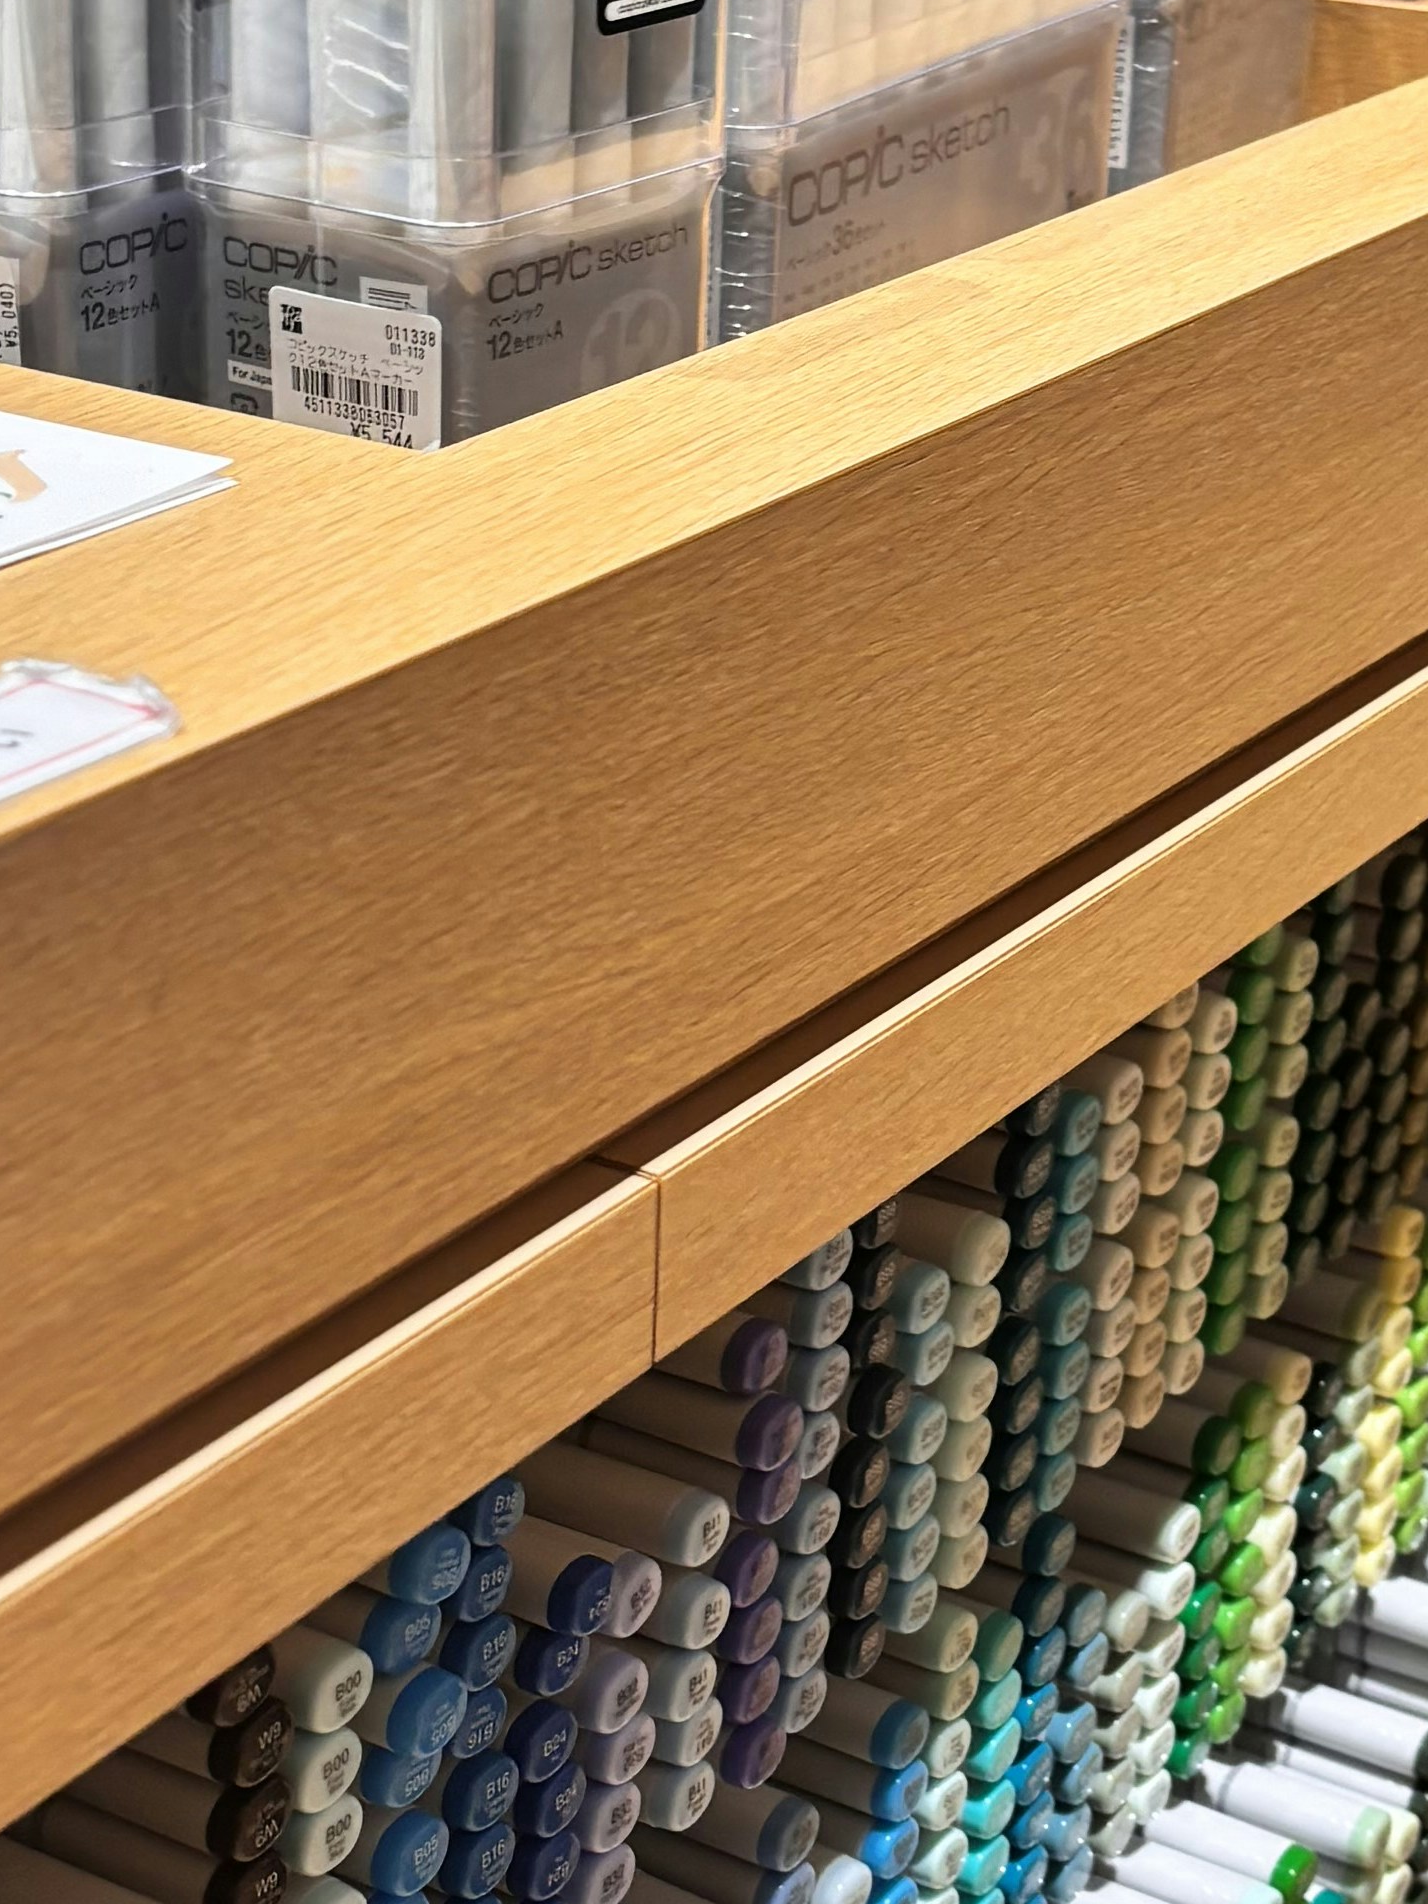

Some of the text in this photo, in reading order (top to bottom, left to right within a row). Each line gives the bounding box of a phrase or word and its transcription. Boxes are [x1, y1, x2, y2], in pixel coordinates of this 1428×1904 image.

[910, 101, 1010, 174] sketch
[597, 223, 688, 271] sketch
[79, 275, 138, 300] ベーシック
[80, 293, 161, 332] 12色セットA
[489, 303, 544, 328] ベーシック
[385, 324, 436, 347] 011338
[487, 320, 563, 361] 12色セットA
[287, 338, 369, 363] コピックスケッチ
[232, 366, 247, 380] For
[336, 1670, 362, 1699] B00
[324, 1747, 350, 1779] B00
[487, 1772, 510, 1799] B16
[326, 1813, 352, 1844] B00
[415, 1836, 438, 1865] B05
[482, 1838, 505, 1867] B16
